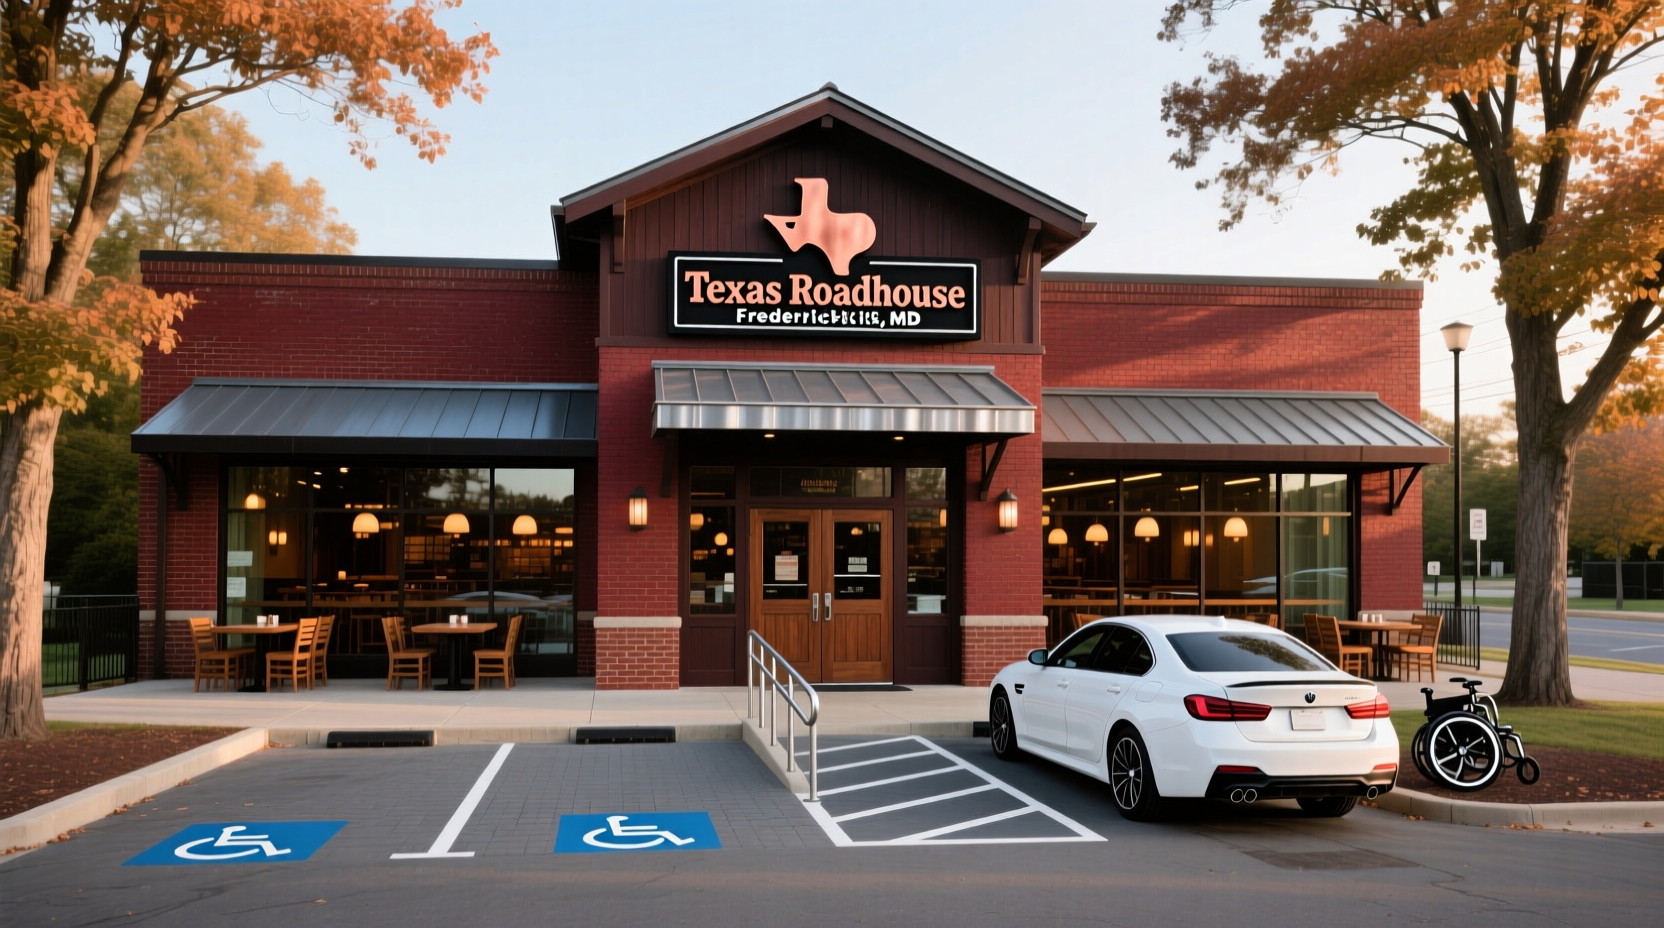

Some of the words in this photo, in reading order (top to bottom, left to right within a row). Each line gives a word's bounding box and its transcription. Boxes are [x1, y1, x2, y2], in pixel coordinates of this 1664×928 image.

[684, 271, 782, 304] Texas
[788, 273, 966, 308] Roadhouse
[889, 310, 921, 326] MD
